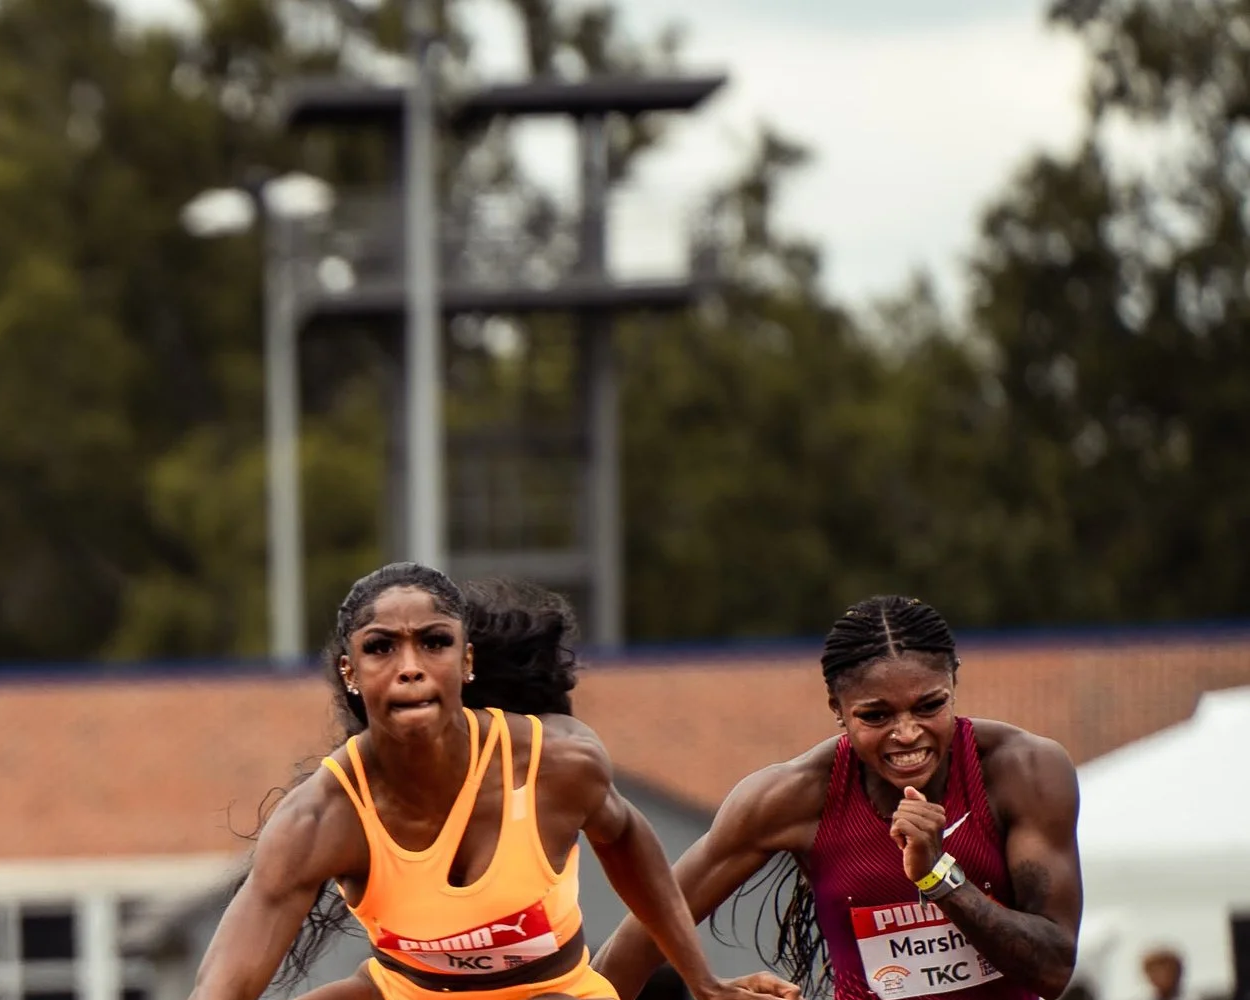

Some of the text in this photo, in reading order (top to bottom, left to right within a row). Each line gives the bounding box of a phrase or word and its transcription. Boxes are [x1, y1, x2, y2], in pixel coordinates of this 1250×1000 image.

[398, 927, 493, 951] PUMA
[889, 930, 970, 959] Marsh
[444, 952, 493, 970] TKC
[920, 961, 971, 987] TKC
